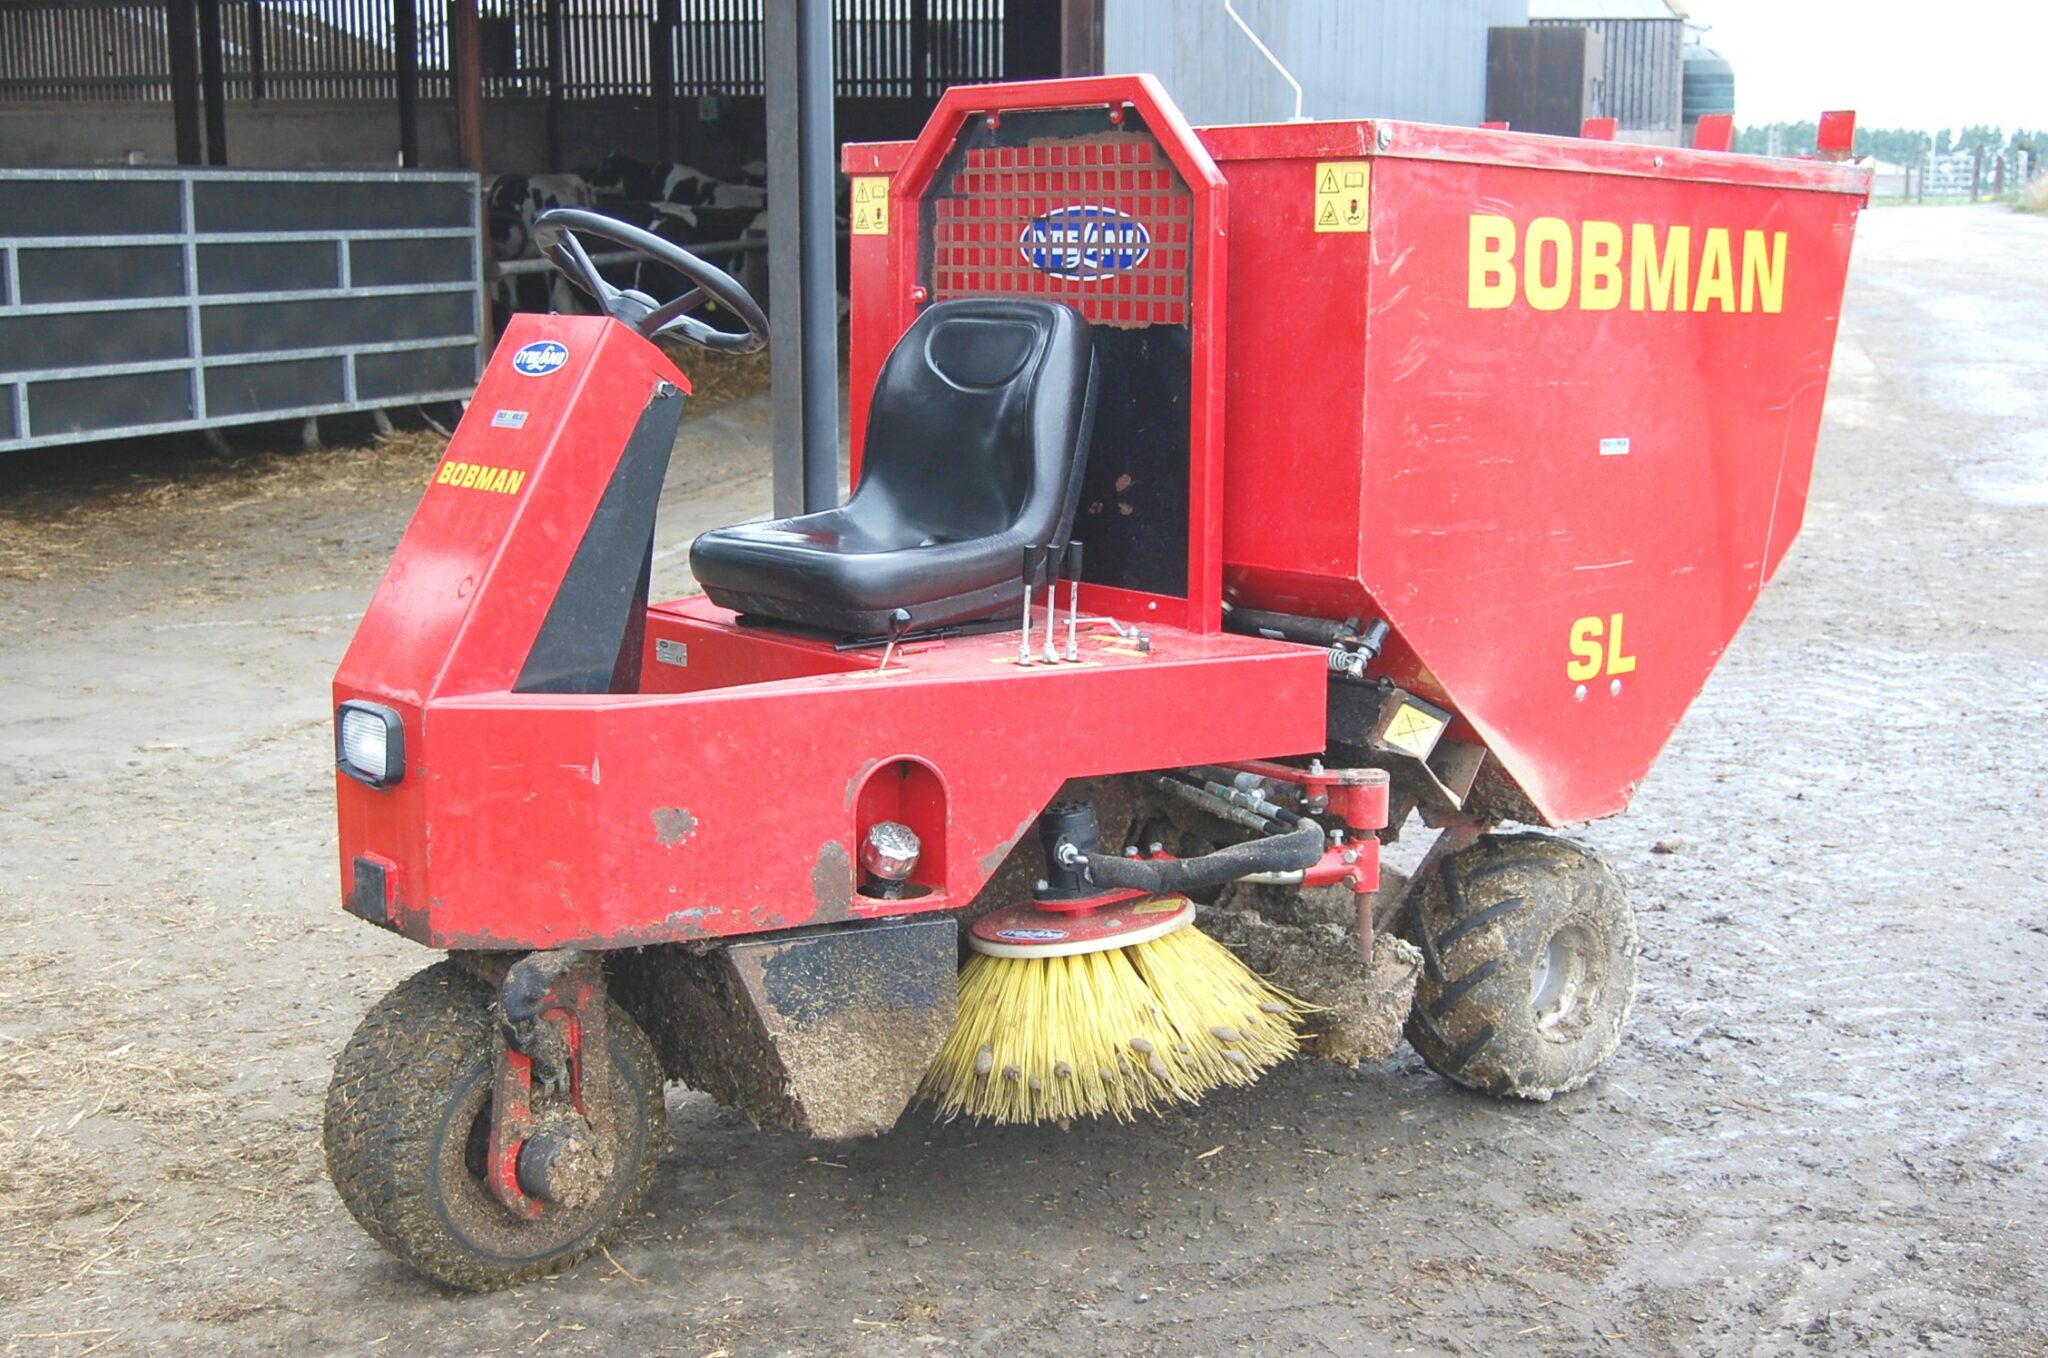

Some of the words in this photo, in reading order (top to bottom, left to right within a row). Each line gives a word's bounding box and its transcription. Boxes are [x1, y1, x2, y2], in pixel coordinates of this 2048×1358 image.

[1468, 214, 1788, 314] BOBMAN
[437, 461, 526, 495] BOBMAN
[1567, 613, 1637, 682] SL
